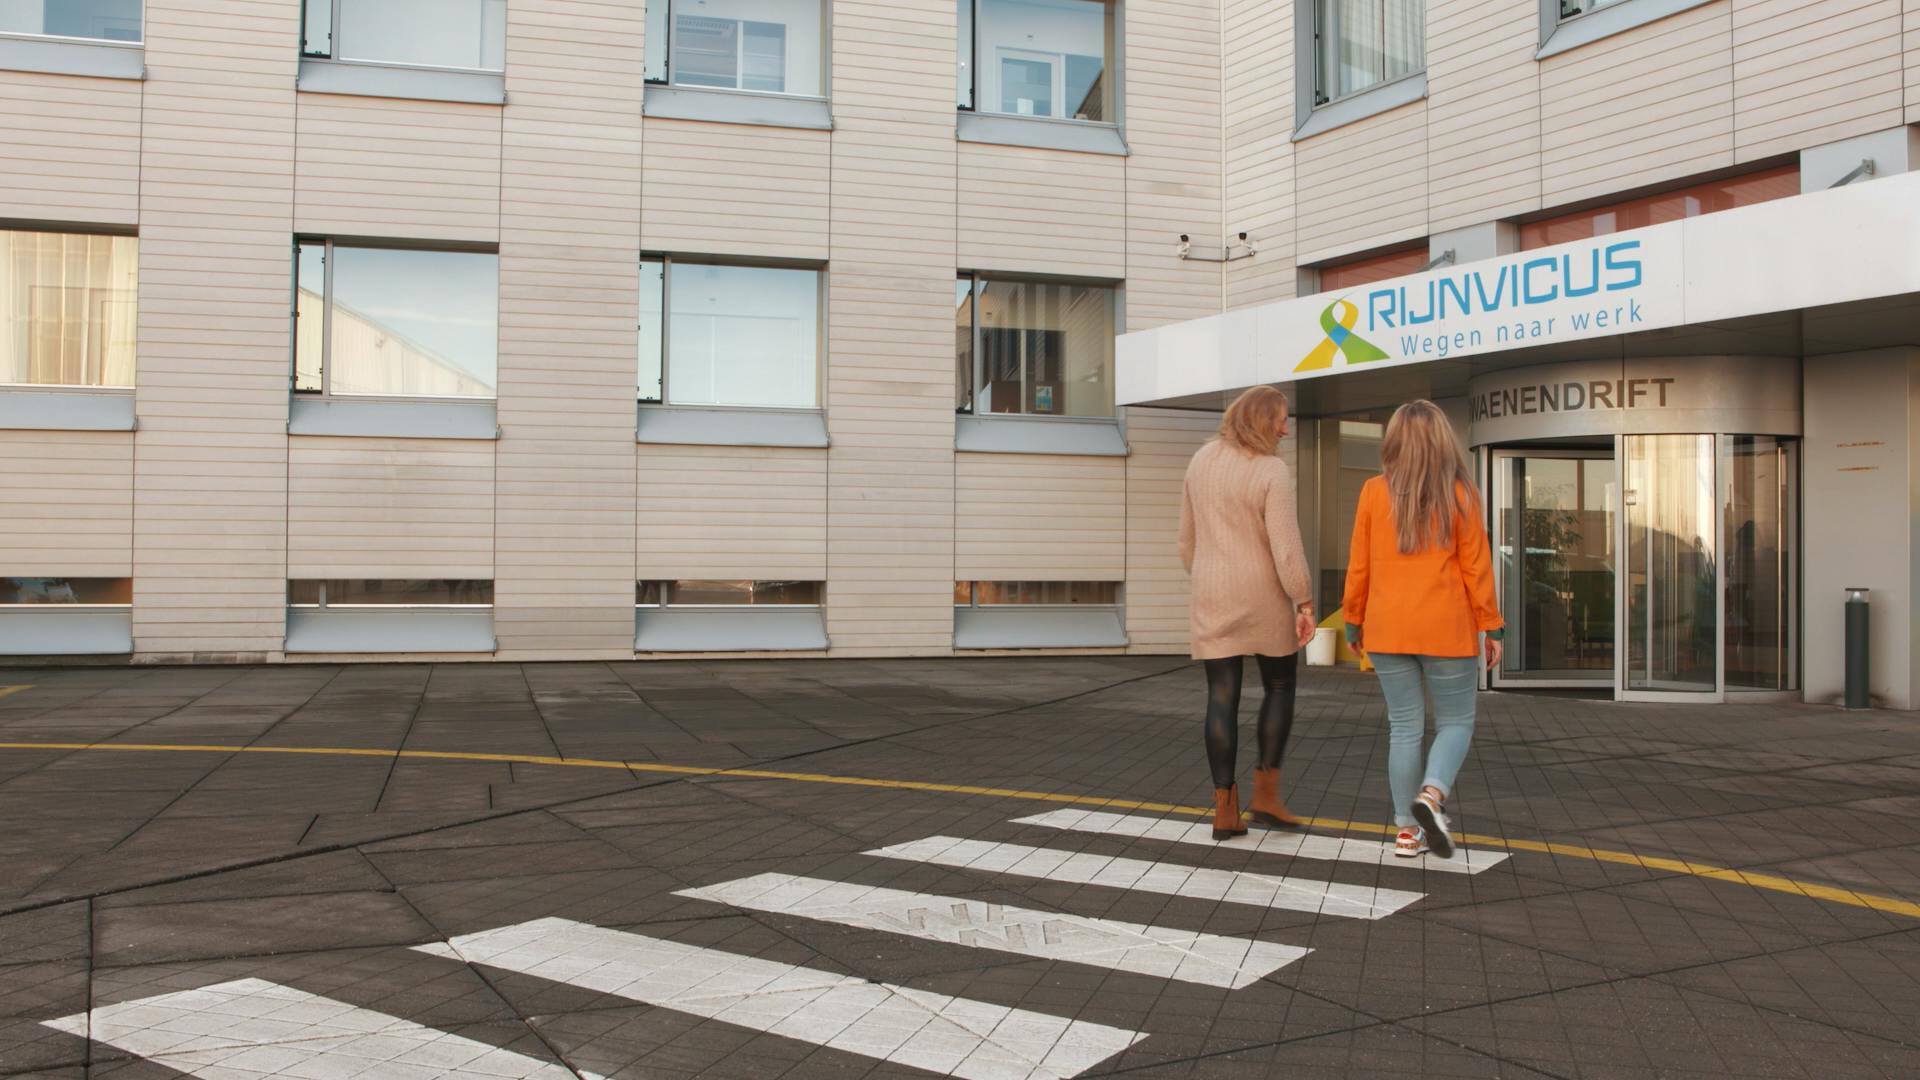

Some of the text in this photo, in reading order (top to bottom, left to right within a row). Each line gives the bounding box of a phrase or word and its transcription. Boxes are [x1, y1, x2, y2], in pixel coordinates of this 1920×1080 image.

[1369, 240, 1642, 331] RIJNVICUS
[1401, 298, 1643, 357] Wegen naar werk
